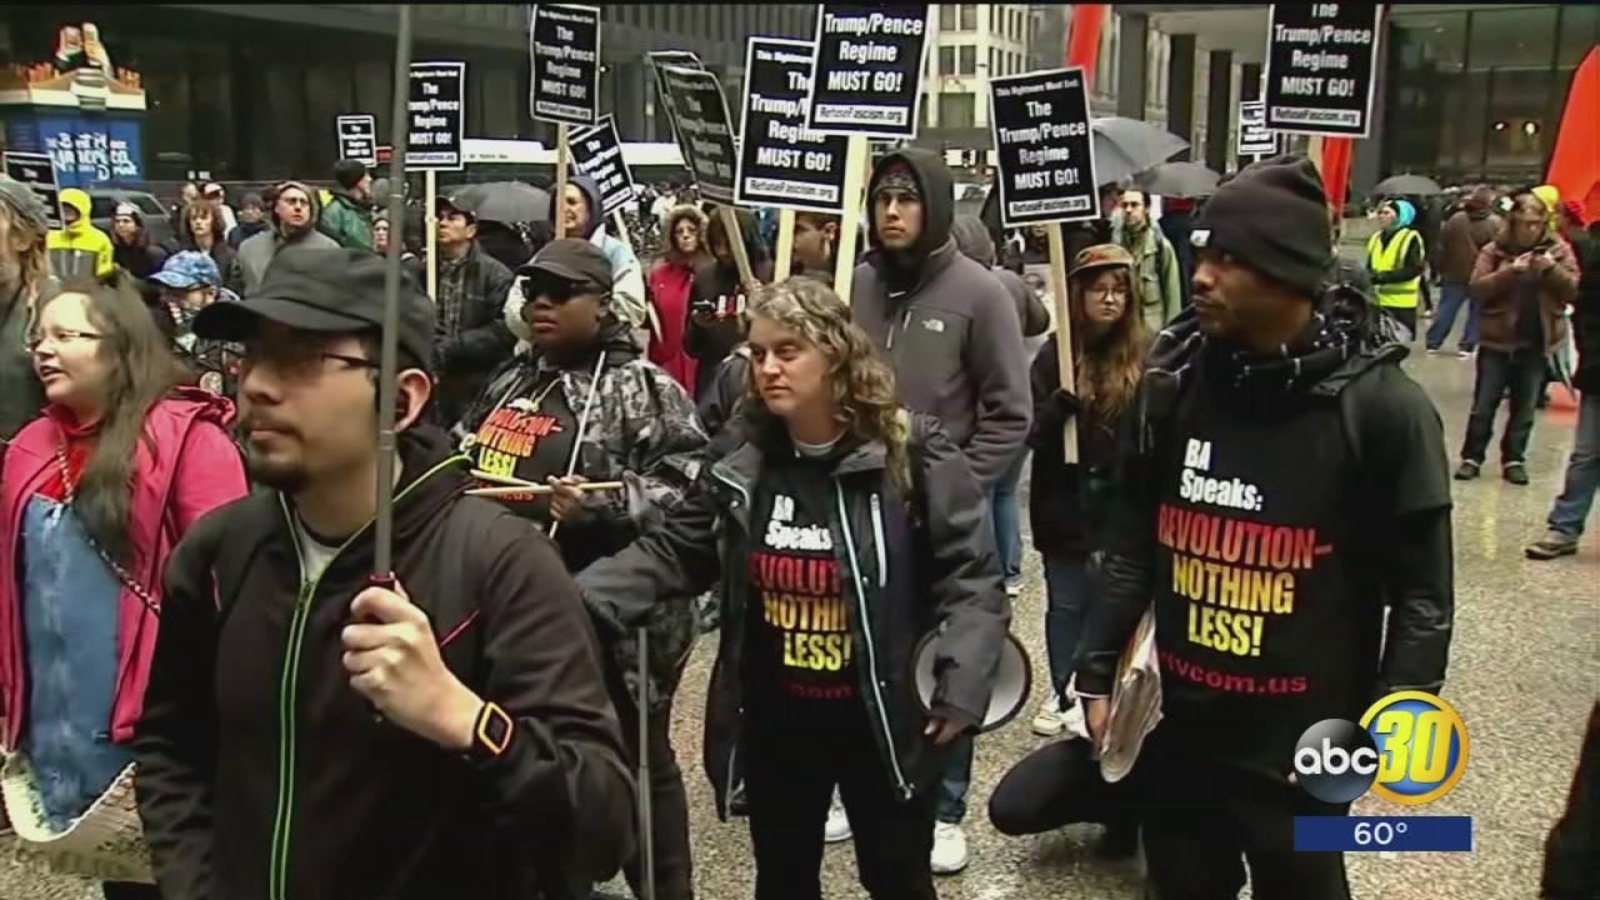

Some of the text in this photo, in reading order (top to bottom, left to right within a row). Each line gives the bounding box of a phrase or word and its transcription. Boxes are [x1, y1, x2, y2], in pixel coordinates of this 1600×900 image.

[556, 25, 575, 41] The
[825, 13, 923, 37] Trump/Pence
[1275, 24, 1372, 47] Trump/Pence
[840, 40, 898, 65] Regime
[1291, 49, 1349, 72] Regime
[422, 82, 440, 95] The
[827, 70, 904, 92] MUST GO!
[1281, 76, 1356, 97] MUST GO!
[1025, 101, 1052, 119] The
[999, 121, 1087, 144] Trump/Pence
[757, 147, 833, 172] MUST GO!
[1019, 145, 1070, 166] Regime
[1014, 168, 1080, 190] MUST GO!
[1184, 438, 1212, 470] BA
[1180, 468, 1263, 511] Speaks:
[1173, 553, 1295, 614] NOTHING
[1188, 603, 1264, 657] LESS!
[784, 632, 853, 672] LESS!
